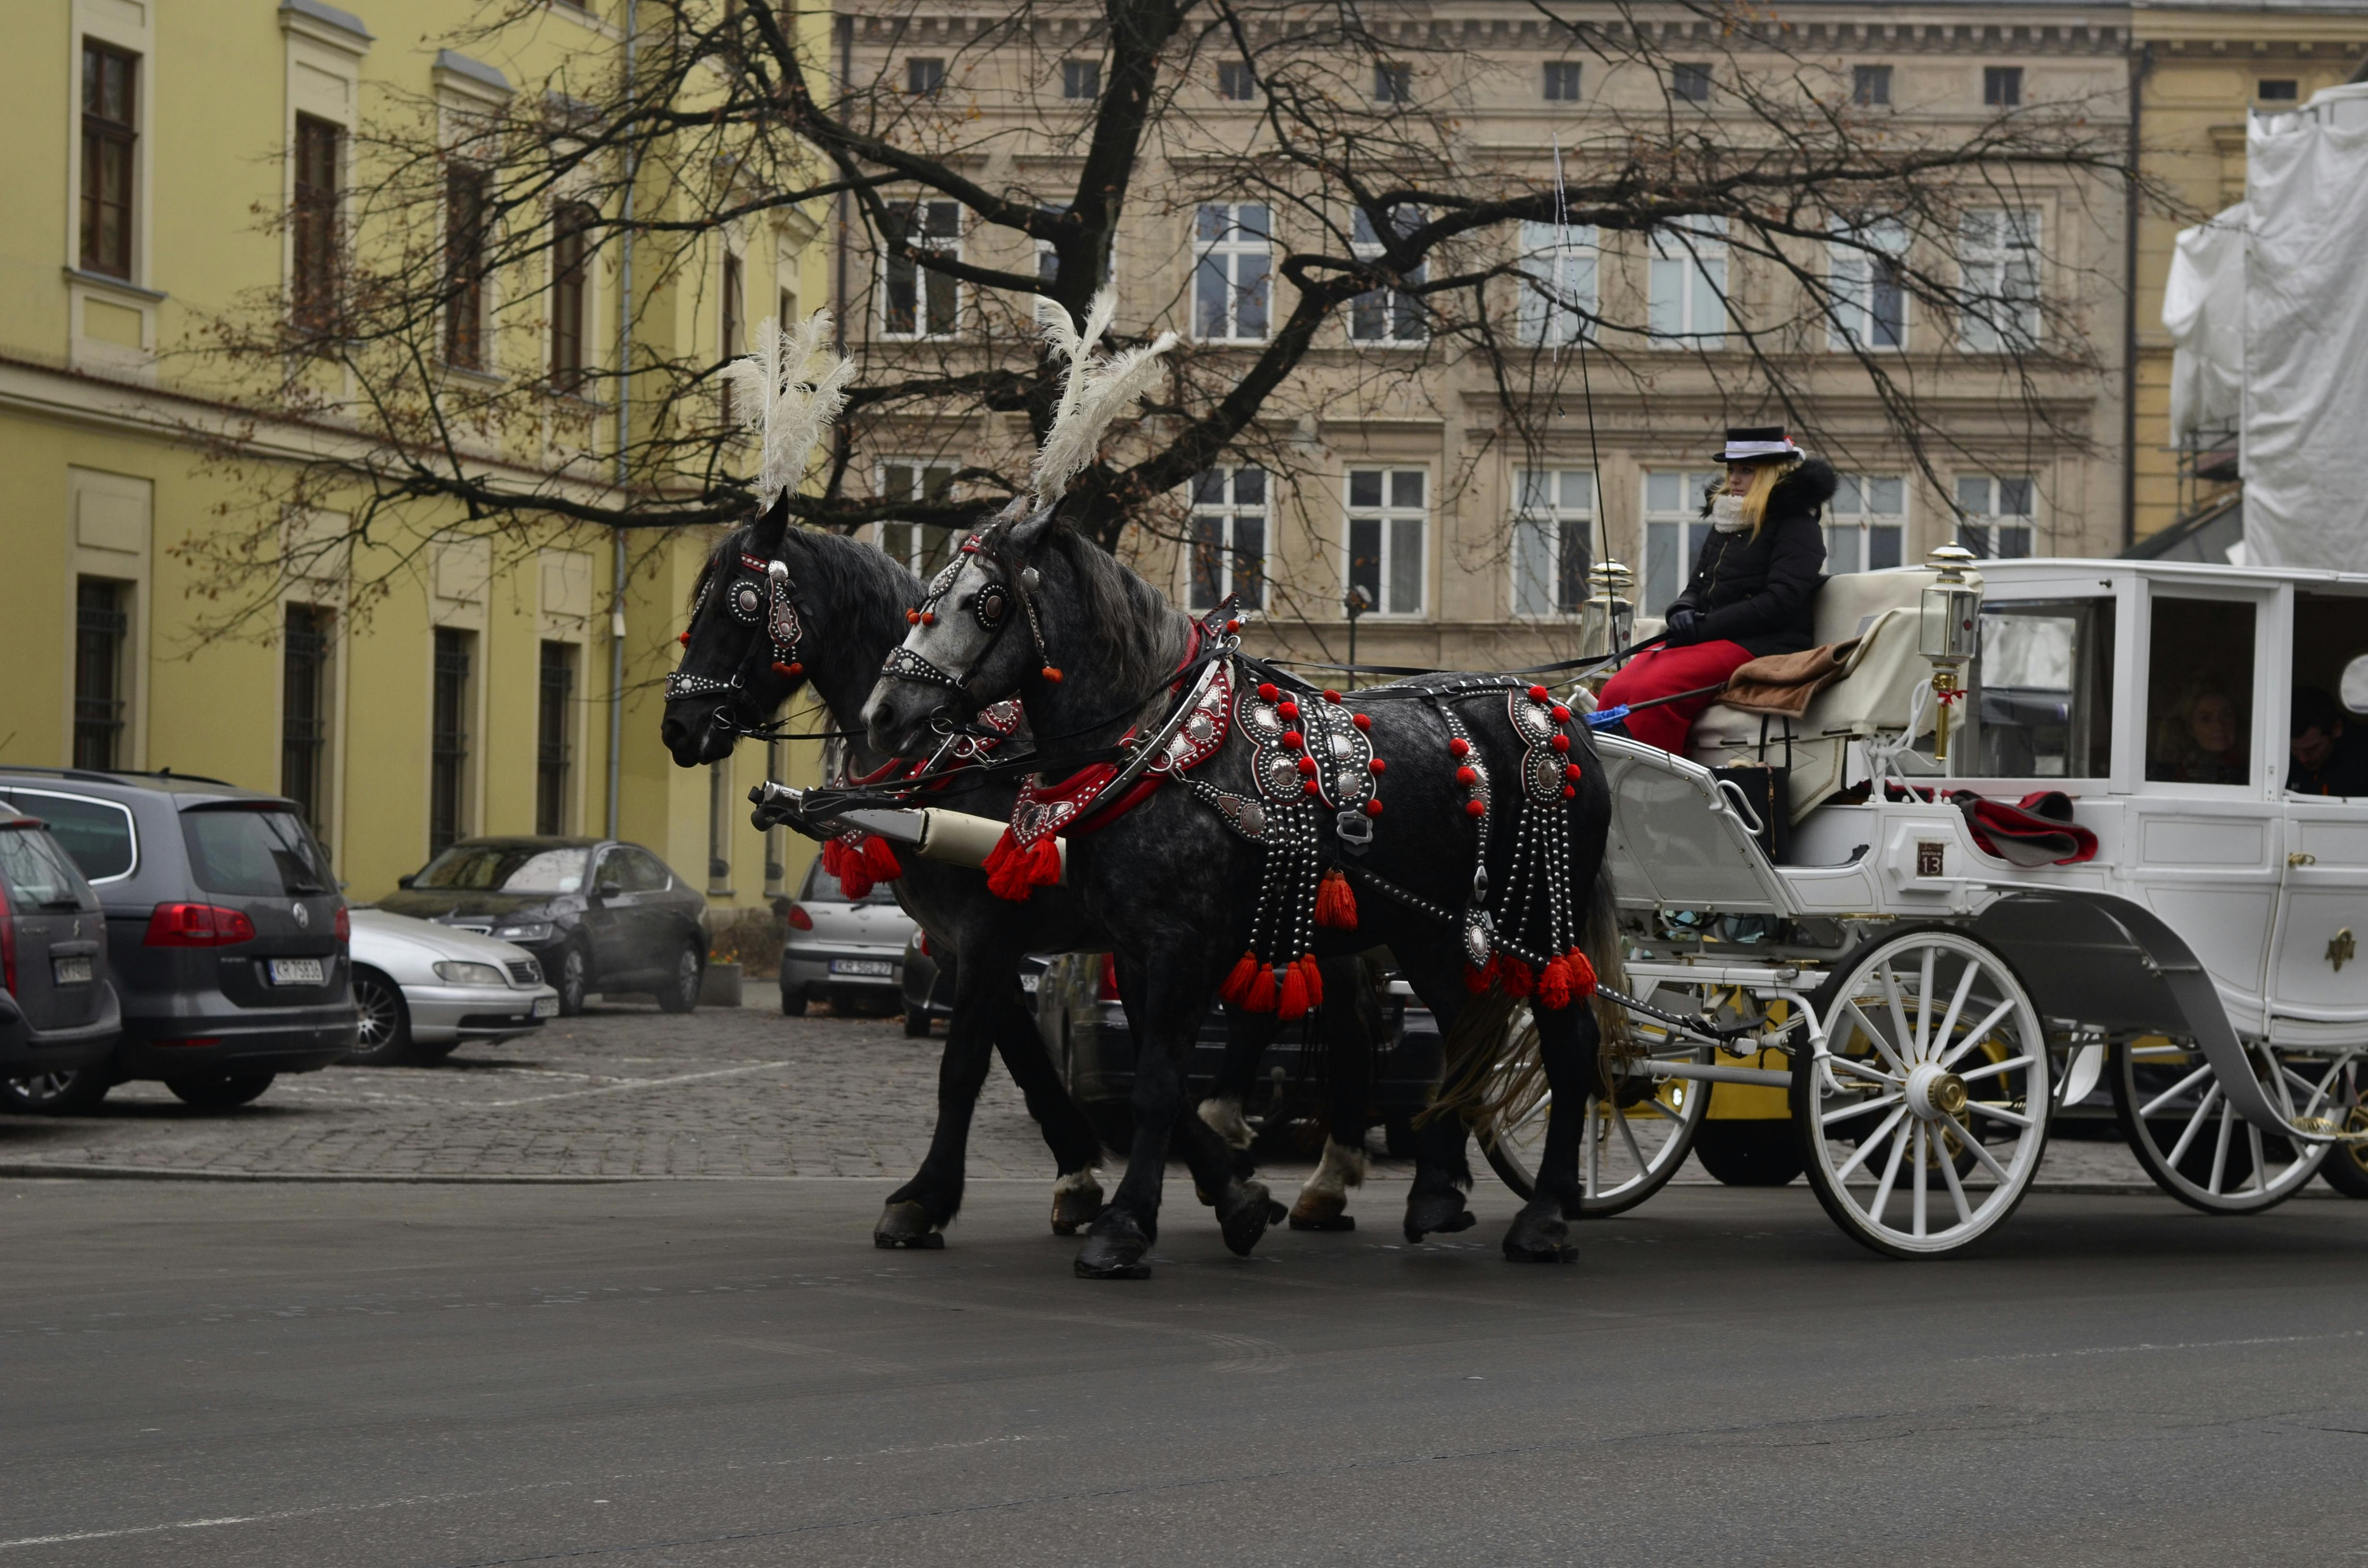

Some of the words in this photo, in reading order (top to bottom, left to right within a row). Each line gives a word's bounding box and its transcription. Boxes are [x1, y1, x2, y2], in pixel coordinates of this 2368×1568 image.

[1923, 857, 1940, 874] 13
[276, 961, 289, 978] KR
[838, 961, 853, 972] KR
